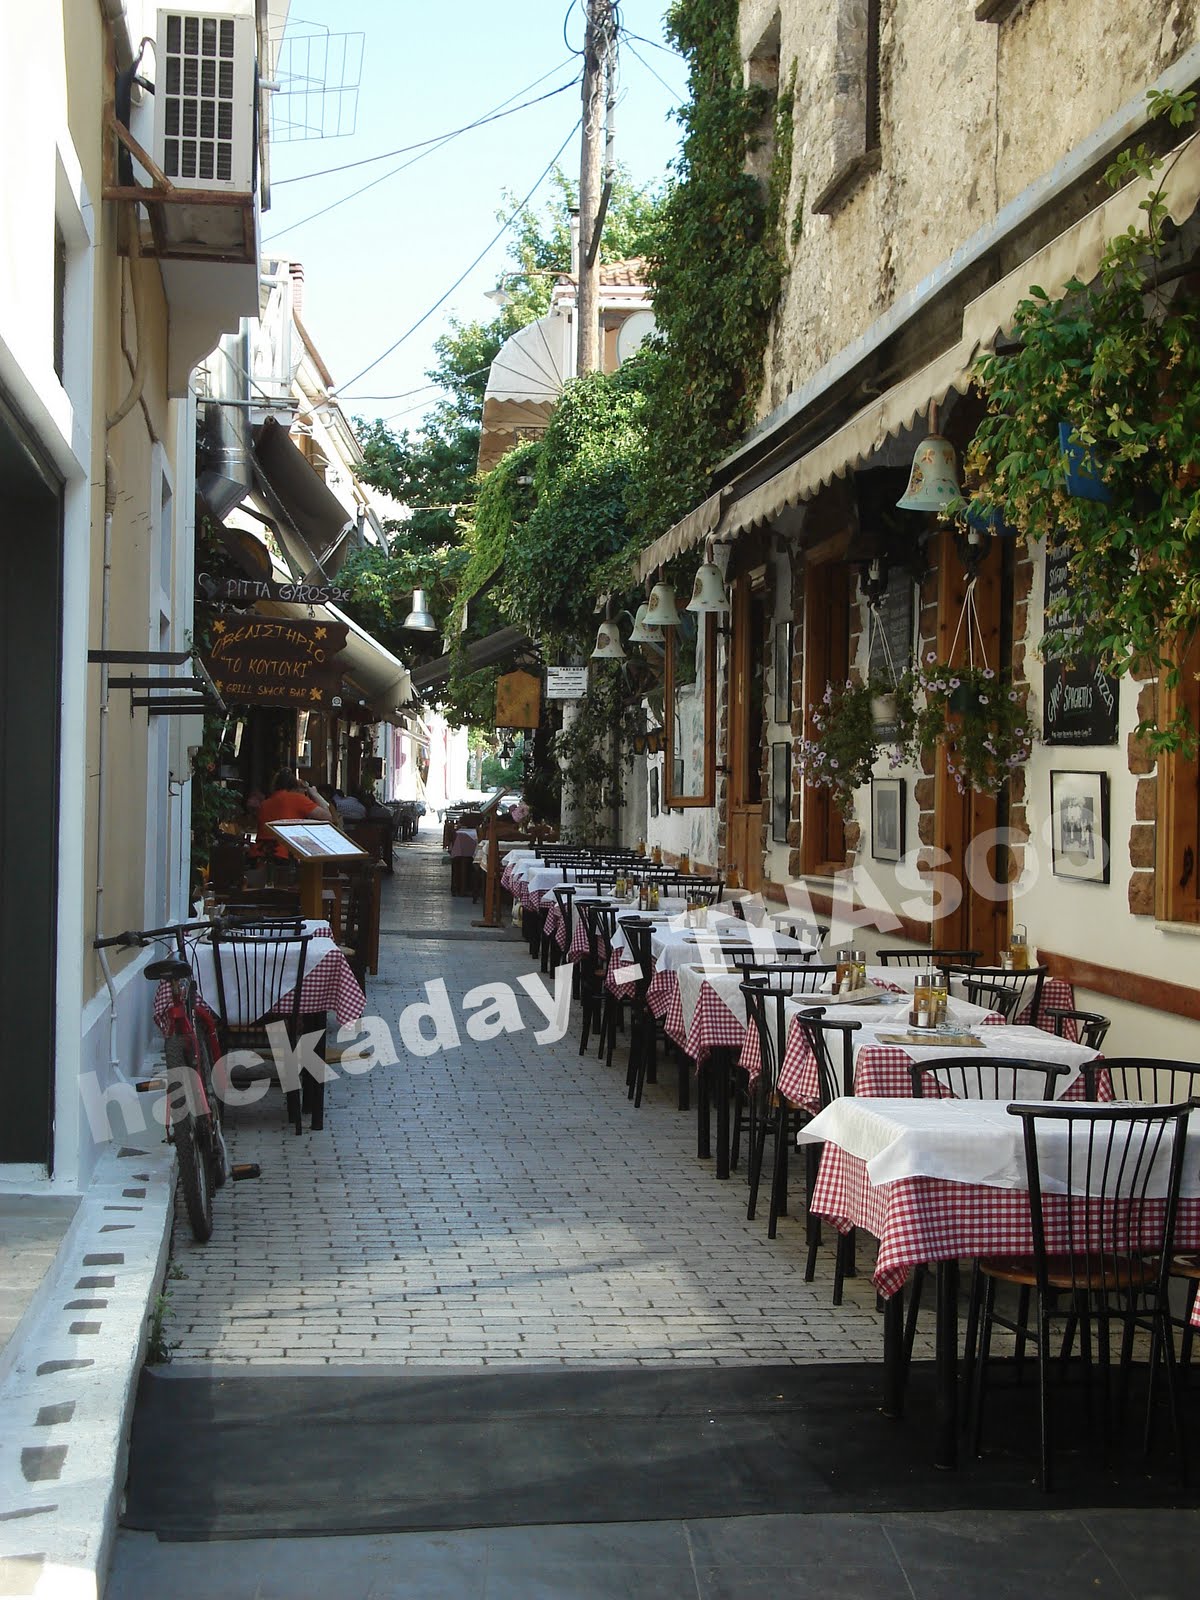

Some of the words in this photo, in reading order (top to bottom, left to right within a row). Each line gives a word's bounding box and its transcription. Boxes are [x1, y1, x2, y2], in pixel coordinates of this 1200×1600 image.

[228, 579, 271, 598] PITTA
[279, 585, 329, 602] GYROS
[226, 683, 252, 694] GRILL
[257, 684, 285, 695] SNACK
[289, 688, 307, 697] BAR
